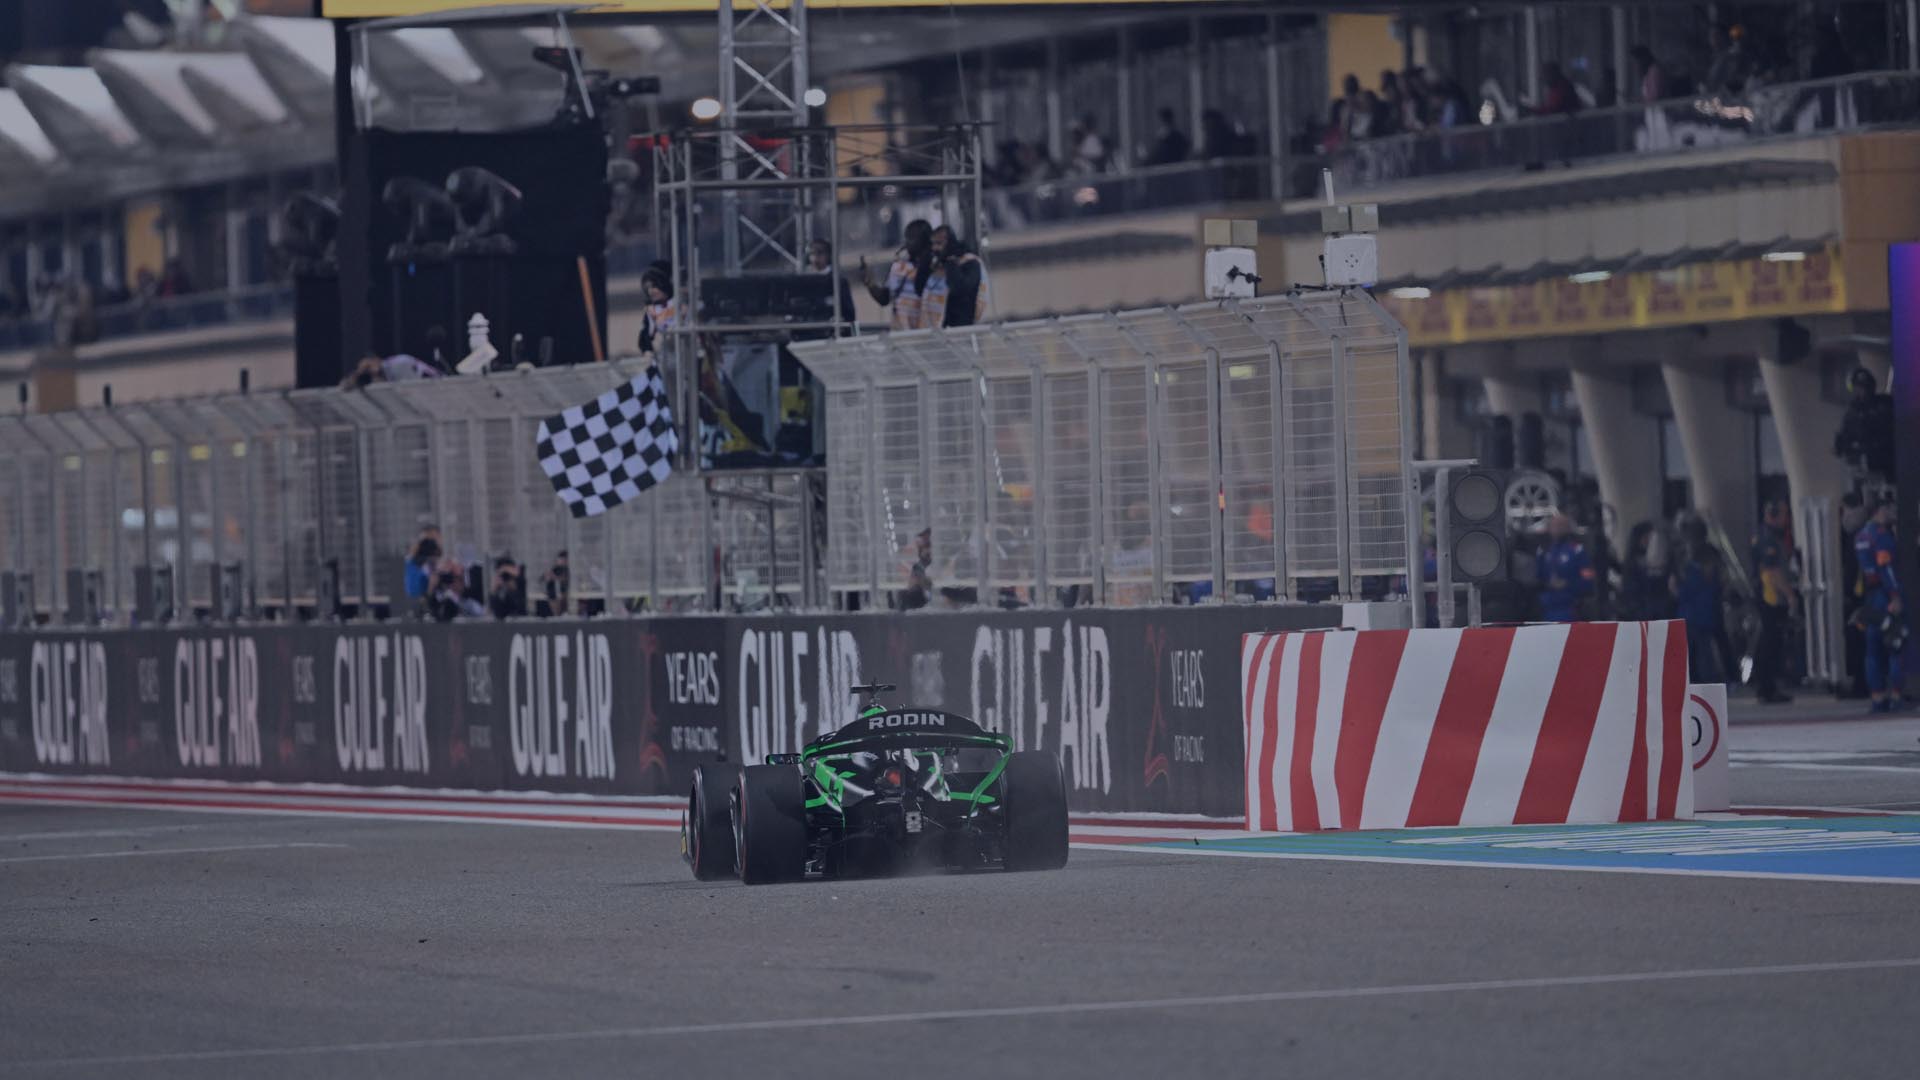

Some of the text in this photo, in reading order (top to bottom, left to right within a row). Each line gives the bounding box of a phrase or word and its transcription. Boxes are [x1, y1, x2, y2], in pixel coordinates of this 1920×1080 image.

[30, 640, 75, 765] GULF
[175, 634, 261, 768] GULF AIR
[333, 630, 429, 774] GULF AIR
[508, 629, 615, 780] GULF AIR
[665, 651, 720, 706] YEARS
[868, 713, 945, 730] RODIN
[1060, 618, 1112, 795] AIR
[1170, 649, 1204, 709] YEARS
